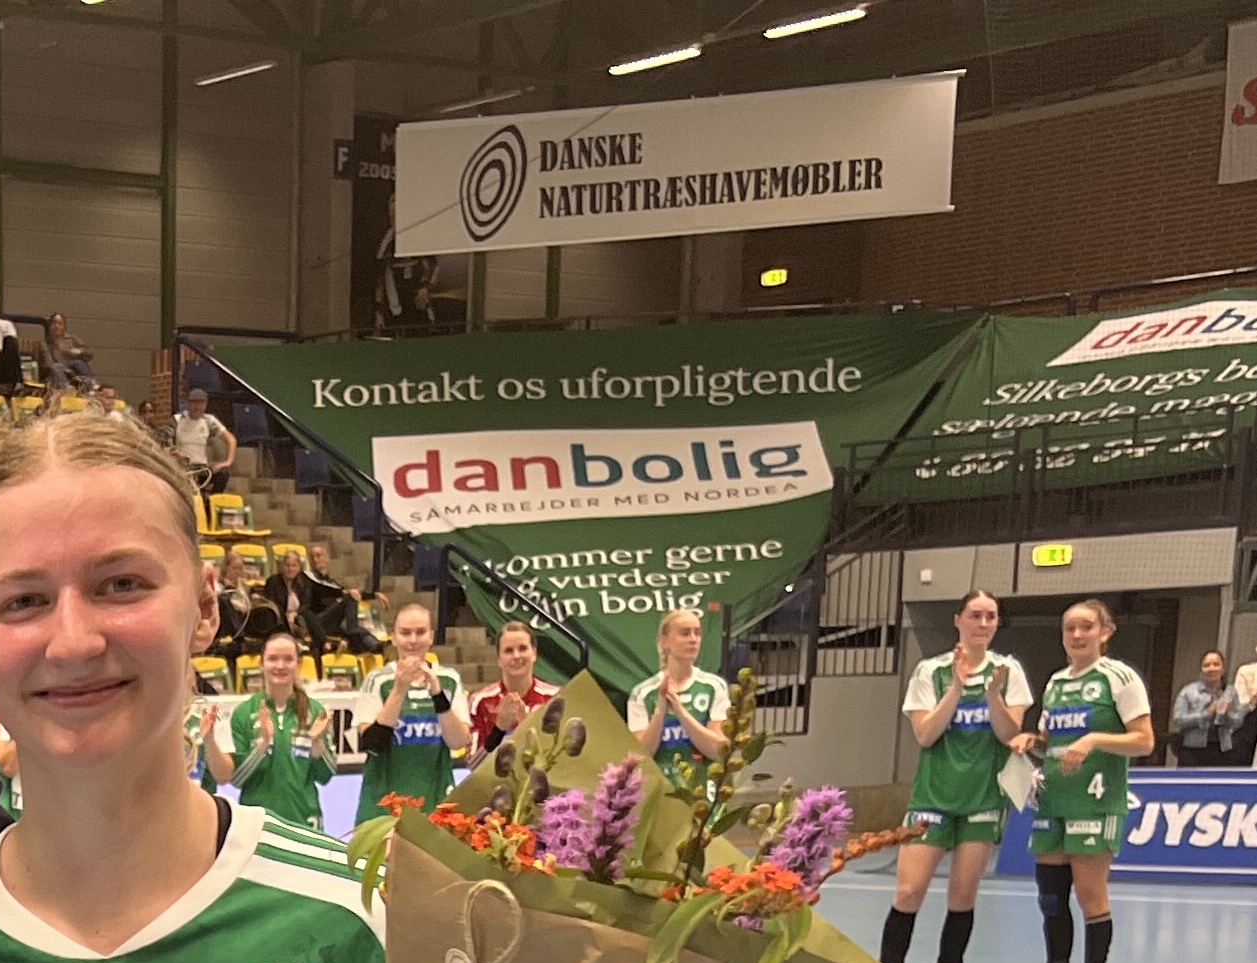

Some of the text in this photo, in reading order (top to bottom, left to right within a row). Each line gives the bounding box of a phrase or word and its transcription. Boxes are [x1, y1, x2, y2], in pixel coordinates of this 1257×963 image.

[539, 133, 644, 172] DANSKE
[538, 157, 883, 219] NATURTRÆSHAVEMØBLER
[313, 358, 862, 408] Kontakt os uforpligtende
[983, 368, 1210, 406] Silkeborgs
[393, 439, 809, 499] danbolig
[409, 481, 799, 524] SAMARBEJDER MED NORDEA
[666, 540, 784, 570] gerne
[549, 568, 732, 590] vurderer
[1049, 712, 1088, 729] JYSK
[1087, 772, 1105, 800] 4
[1127, 802, 1257, 848] JYSK
